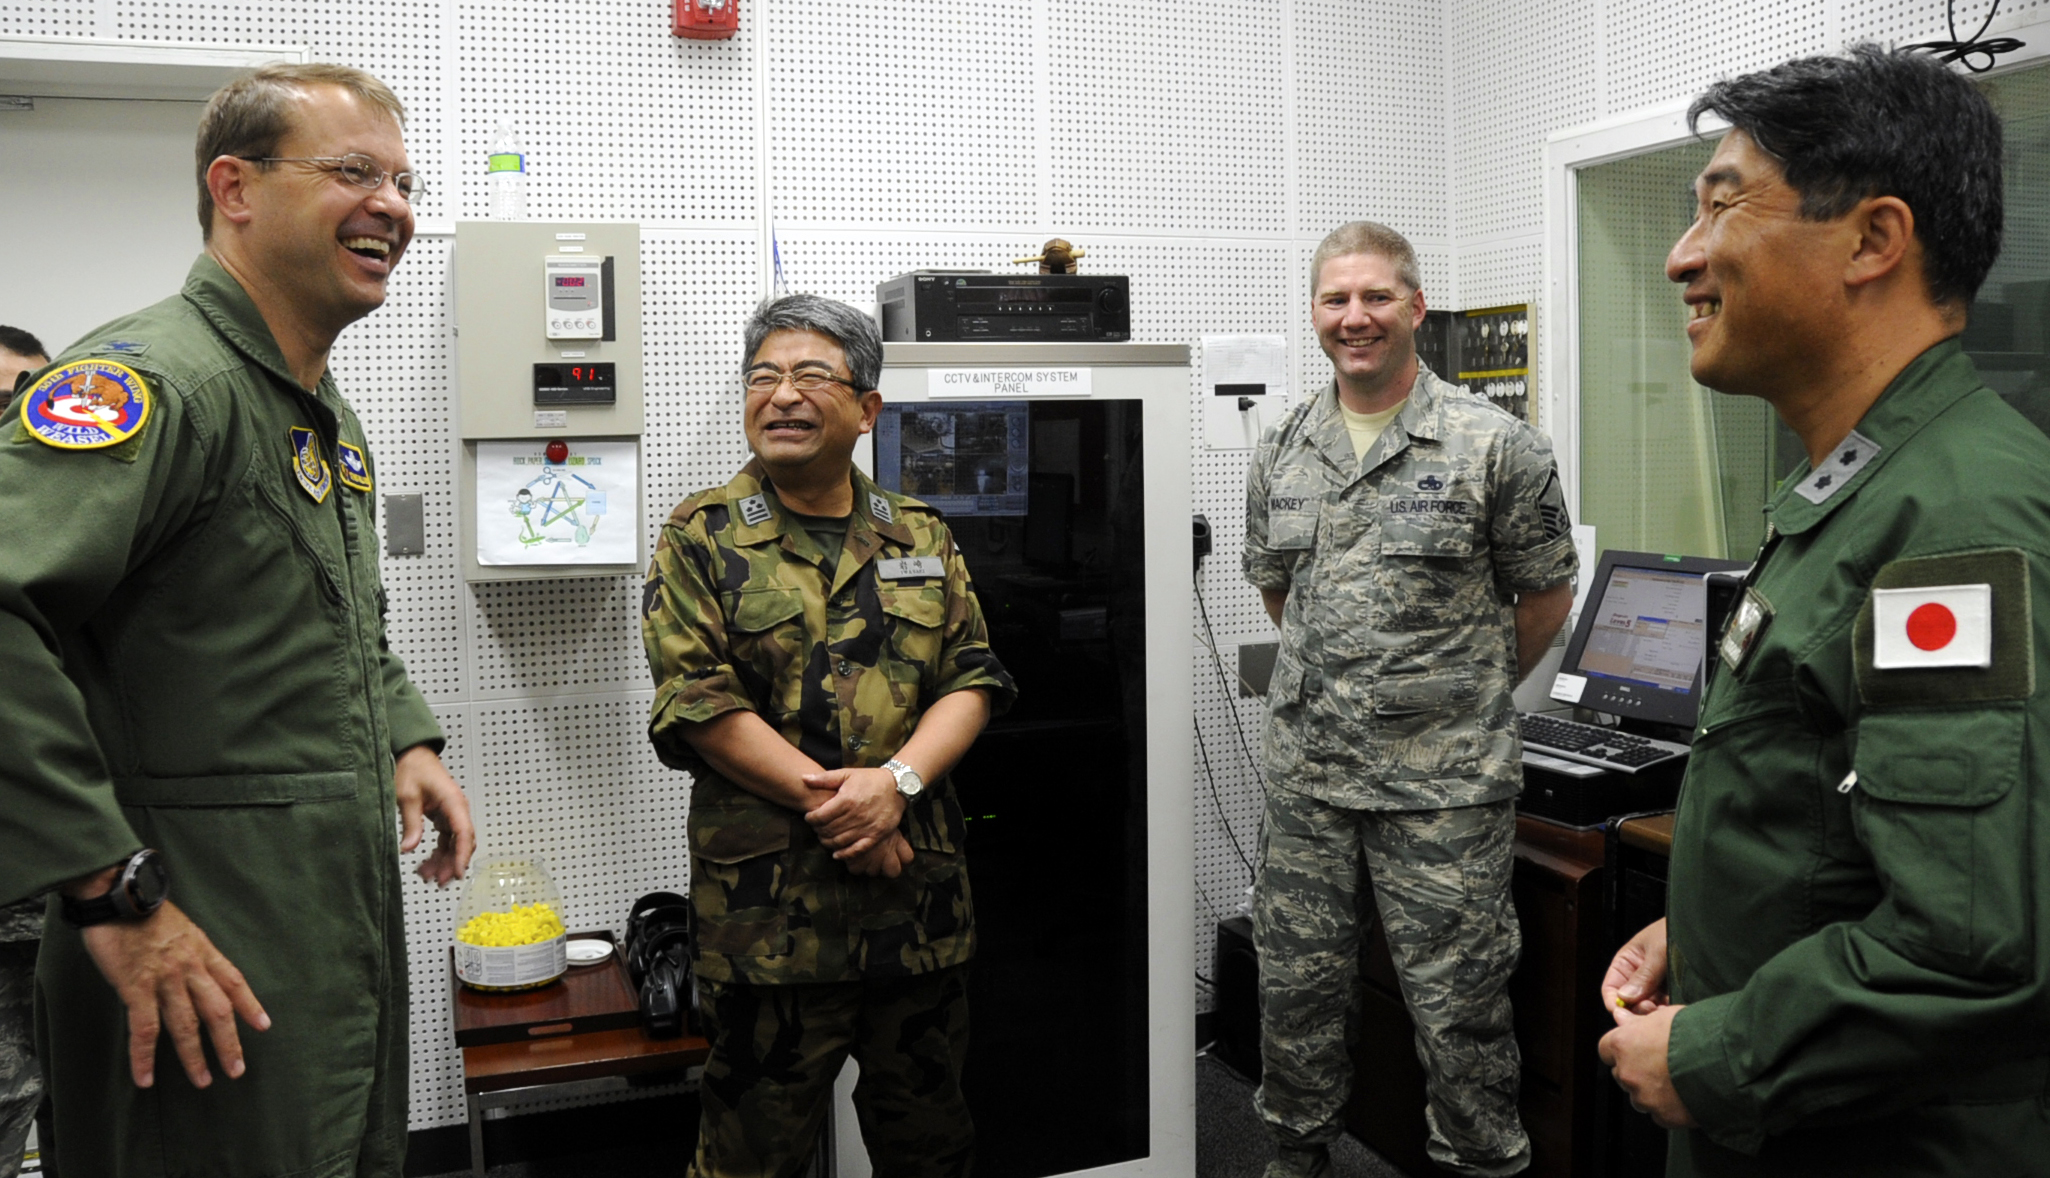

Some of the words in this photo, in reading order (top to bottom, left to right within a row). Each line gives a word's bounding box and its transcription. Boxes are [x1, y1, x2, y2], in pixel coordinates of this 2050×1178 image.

[67, 363, 125, 379] FIGHTER
[124, 376, 143, 404] WING
[1036, 371, 1078, 382] SYSTEM
[994, 382, 1029, 393] PANEL
[36, 425, 115, 445] WEASEL
[52, 422, 100, 436] WILD
[1409, 500, 1431, 513] AIR
[1432, 500, 1467, 515] FORCE
